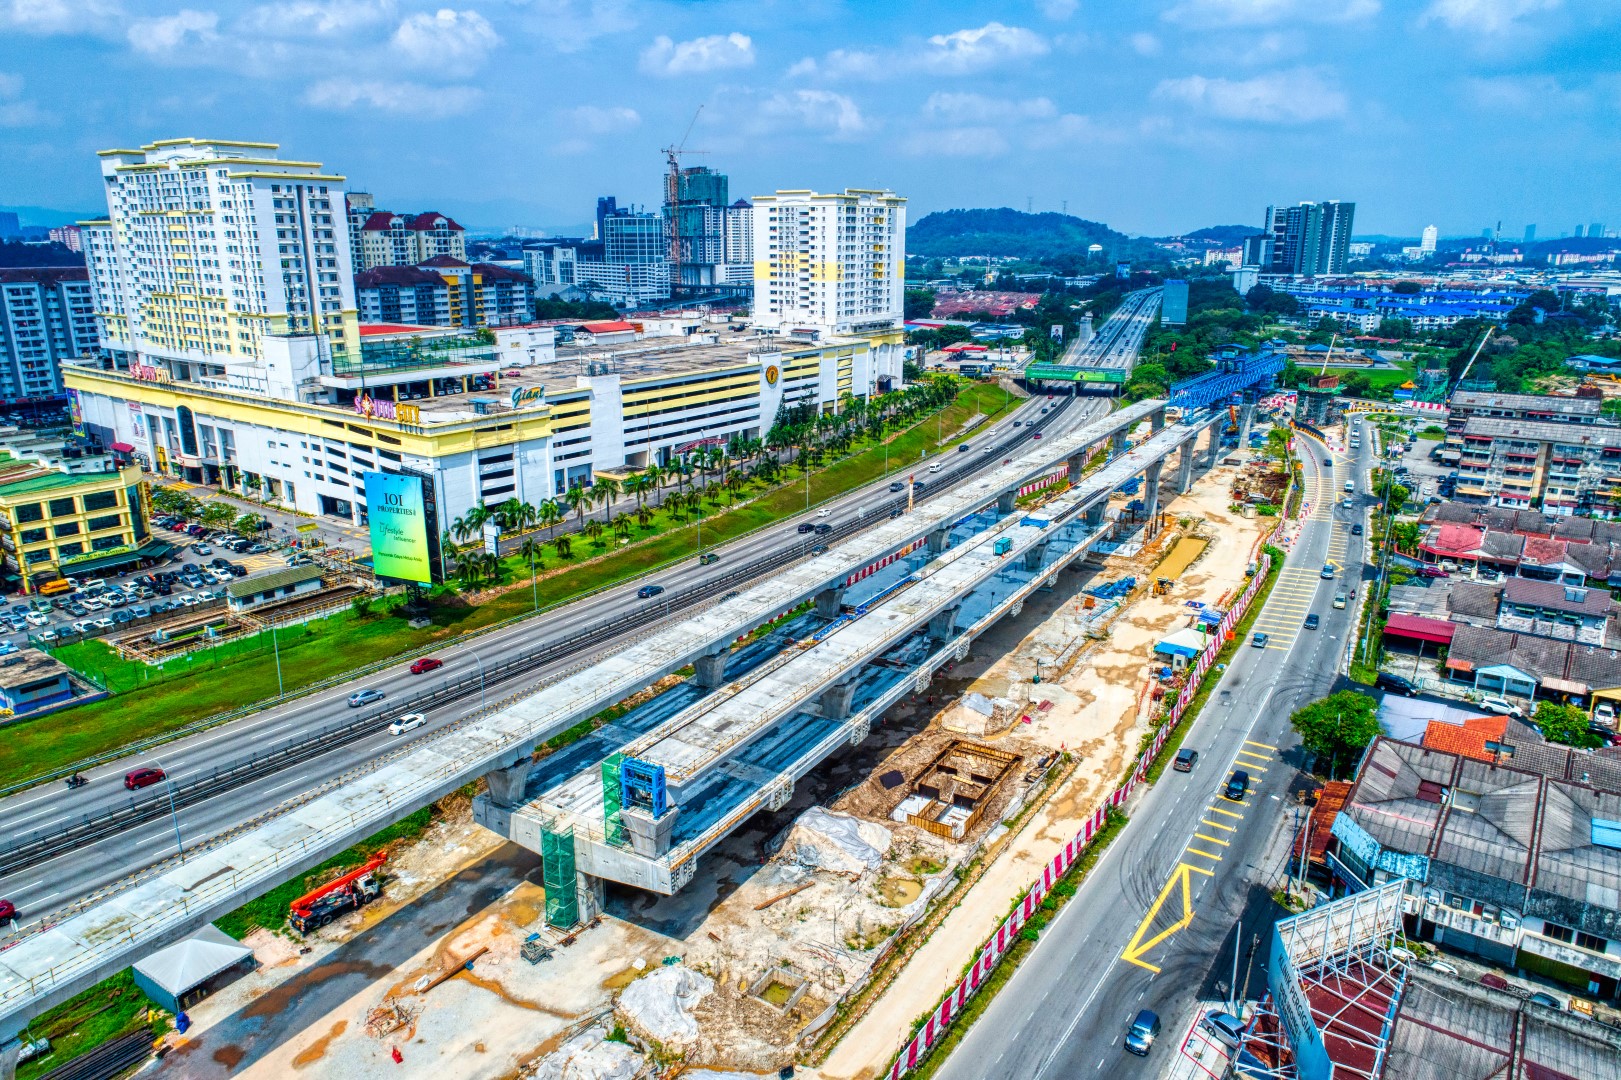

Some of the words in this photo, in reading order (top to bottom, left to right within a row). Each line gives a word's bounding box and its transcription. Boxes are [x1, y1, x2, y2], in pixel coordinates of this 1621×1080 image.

[511, 384, 545, 408] Giant
[354, 393, 395, 420] SOUTH
[395, 403, 420, 424] CITY
[384, 493, 403, 506] IOI
[377, 506, 412, 515] PROPERTIES
[379, 523, 404, 536] Lifestyle
[1278, 953, 1292, 988] KLINIK
[1289, 985, 1315, 1045] PERGIGIAN
